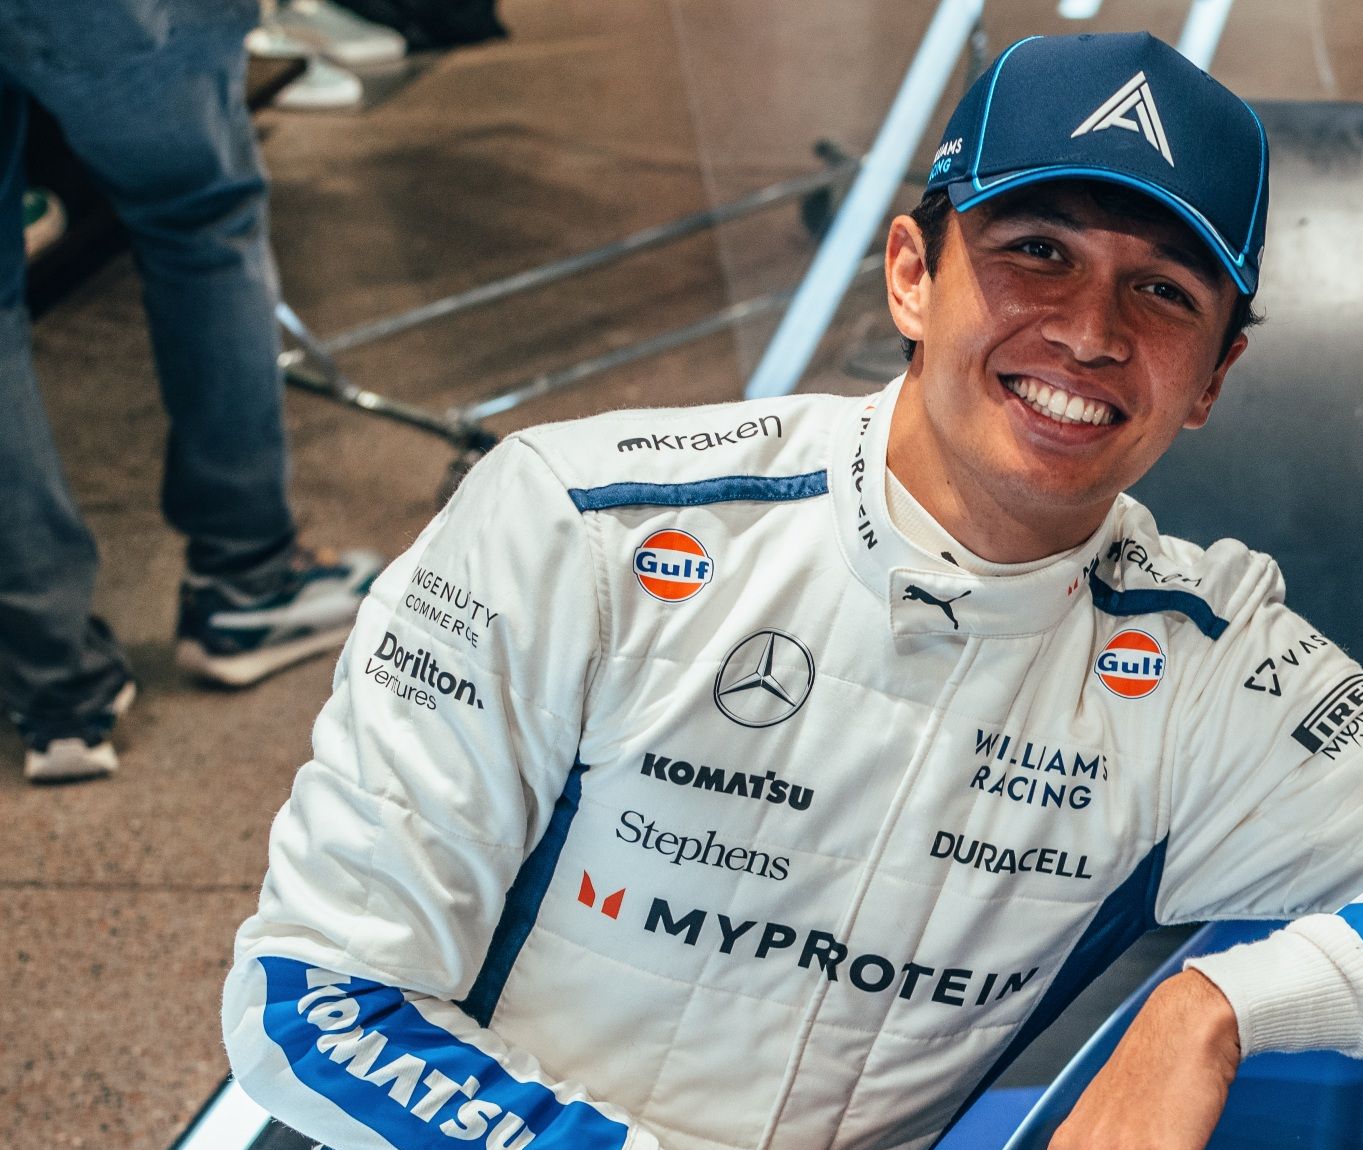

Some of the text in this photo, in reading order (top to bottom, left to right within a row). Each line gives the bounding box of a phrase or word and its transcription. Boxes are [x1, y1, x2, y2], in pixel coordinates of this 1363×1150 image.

[652, 415, 783, 453] kraken
[636, 549, 711, 582] Gulf
[405, 594, 479, 649] COMMERCE
[1097, 650, 1163, 678] Gulf
[1281, 634, 1329, 666] VAS
[364, 657, 438, 711] Ventures
[974, 729, 1108, 782] WILIAMS
[640, 752, 815, 812] KOMATSU
[969, 765, 1092, 810] RACING
[615, 810, 790, 881] Stephens
[930, 830, 1093, 880] DURACELL
